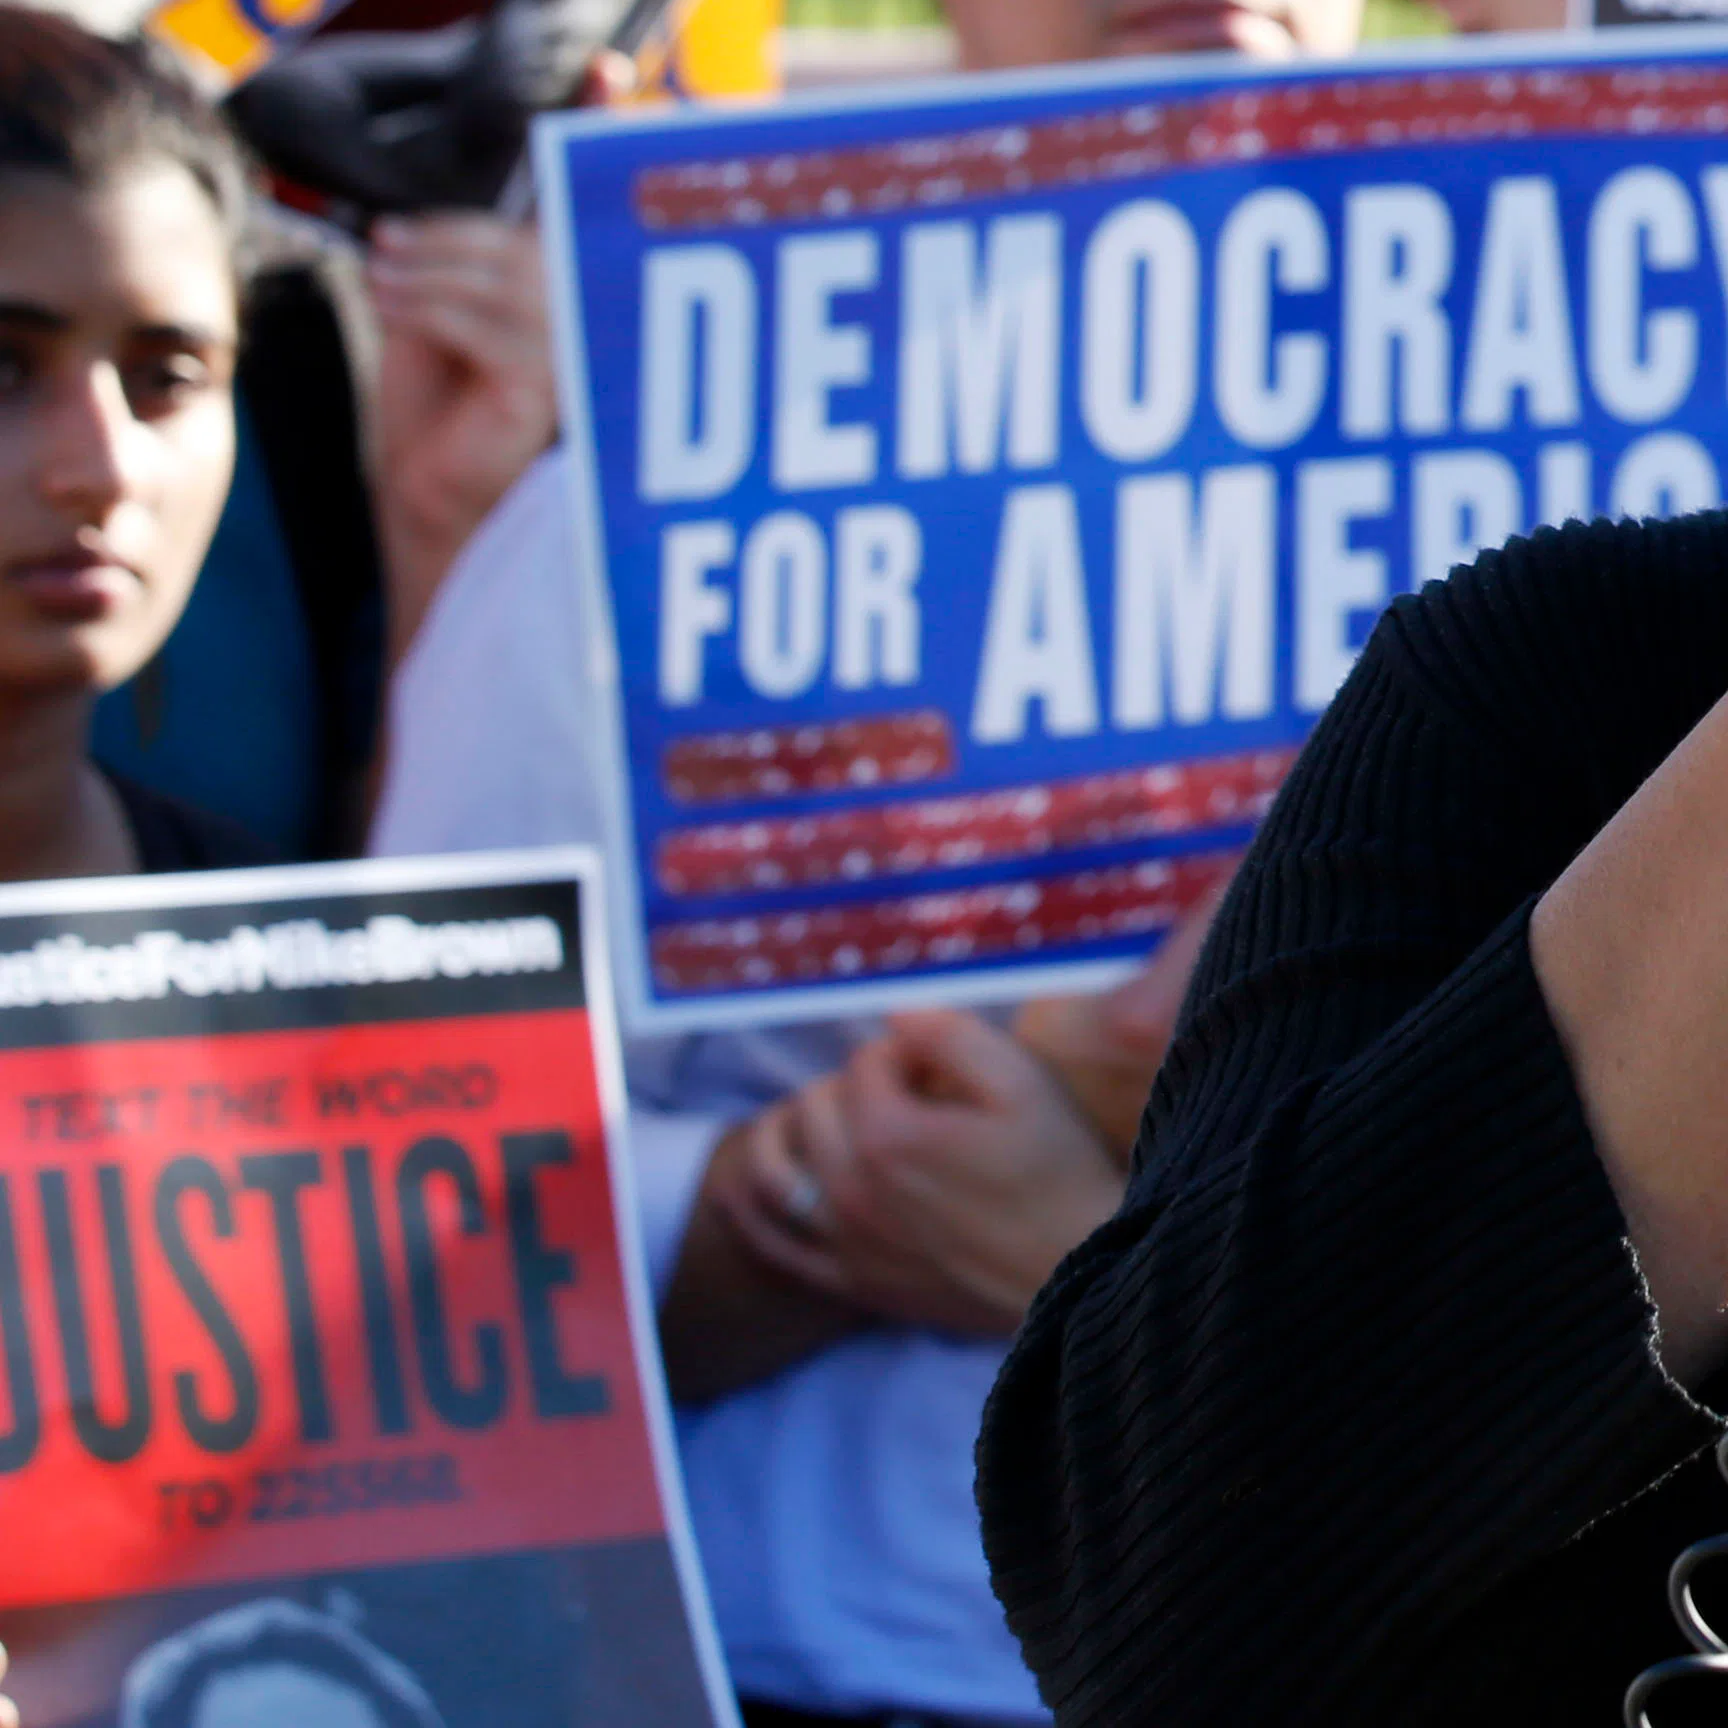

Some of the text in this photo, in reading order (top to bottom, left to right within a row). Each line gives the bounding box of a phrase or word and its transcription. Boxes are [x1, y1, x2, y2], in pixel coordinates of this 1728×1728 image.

[658, 503, 923, 710] FOR
[21, 1063, 498, 1142] TEXT THE WORD
[160, 1479, 234, 1532] TO
